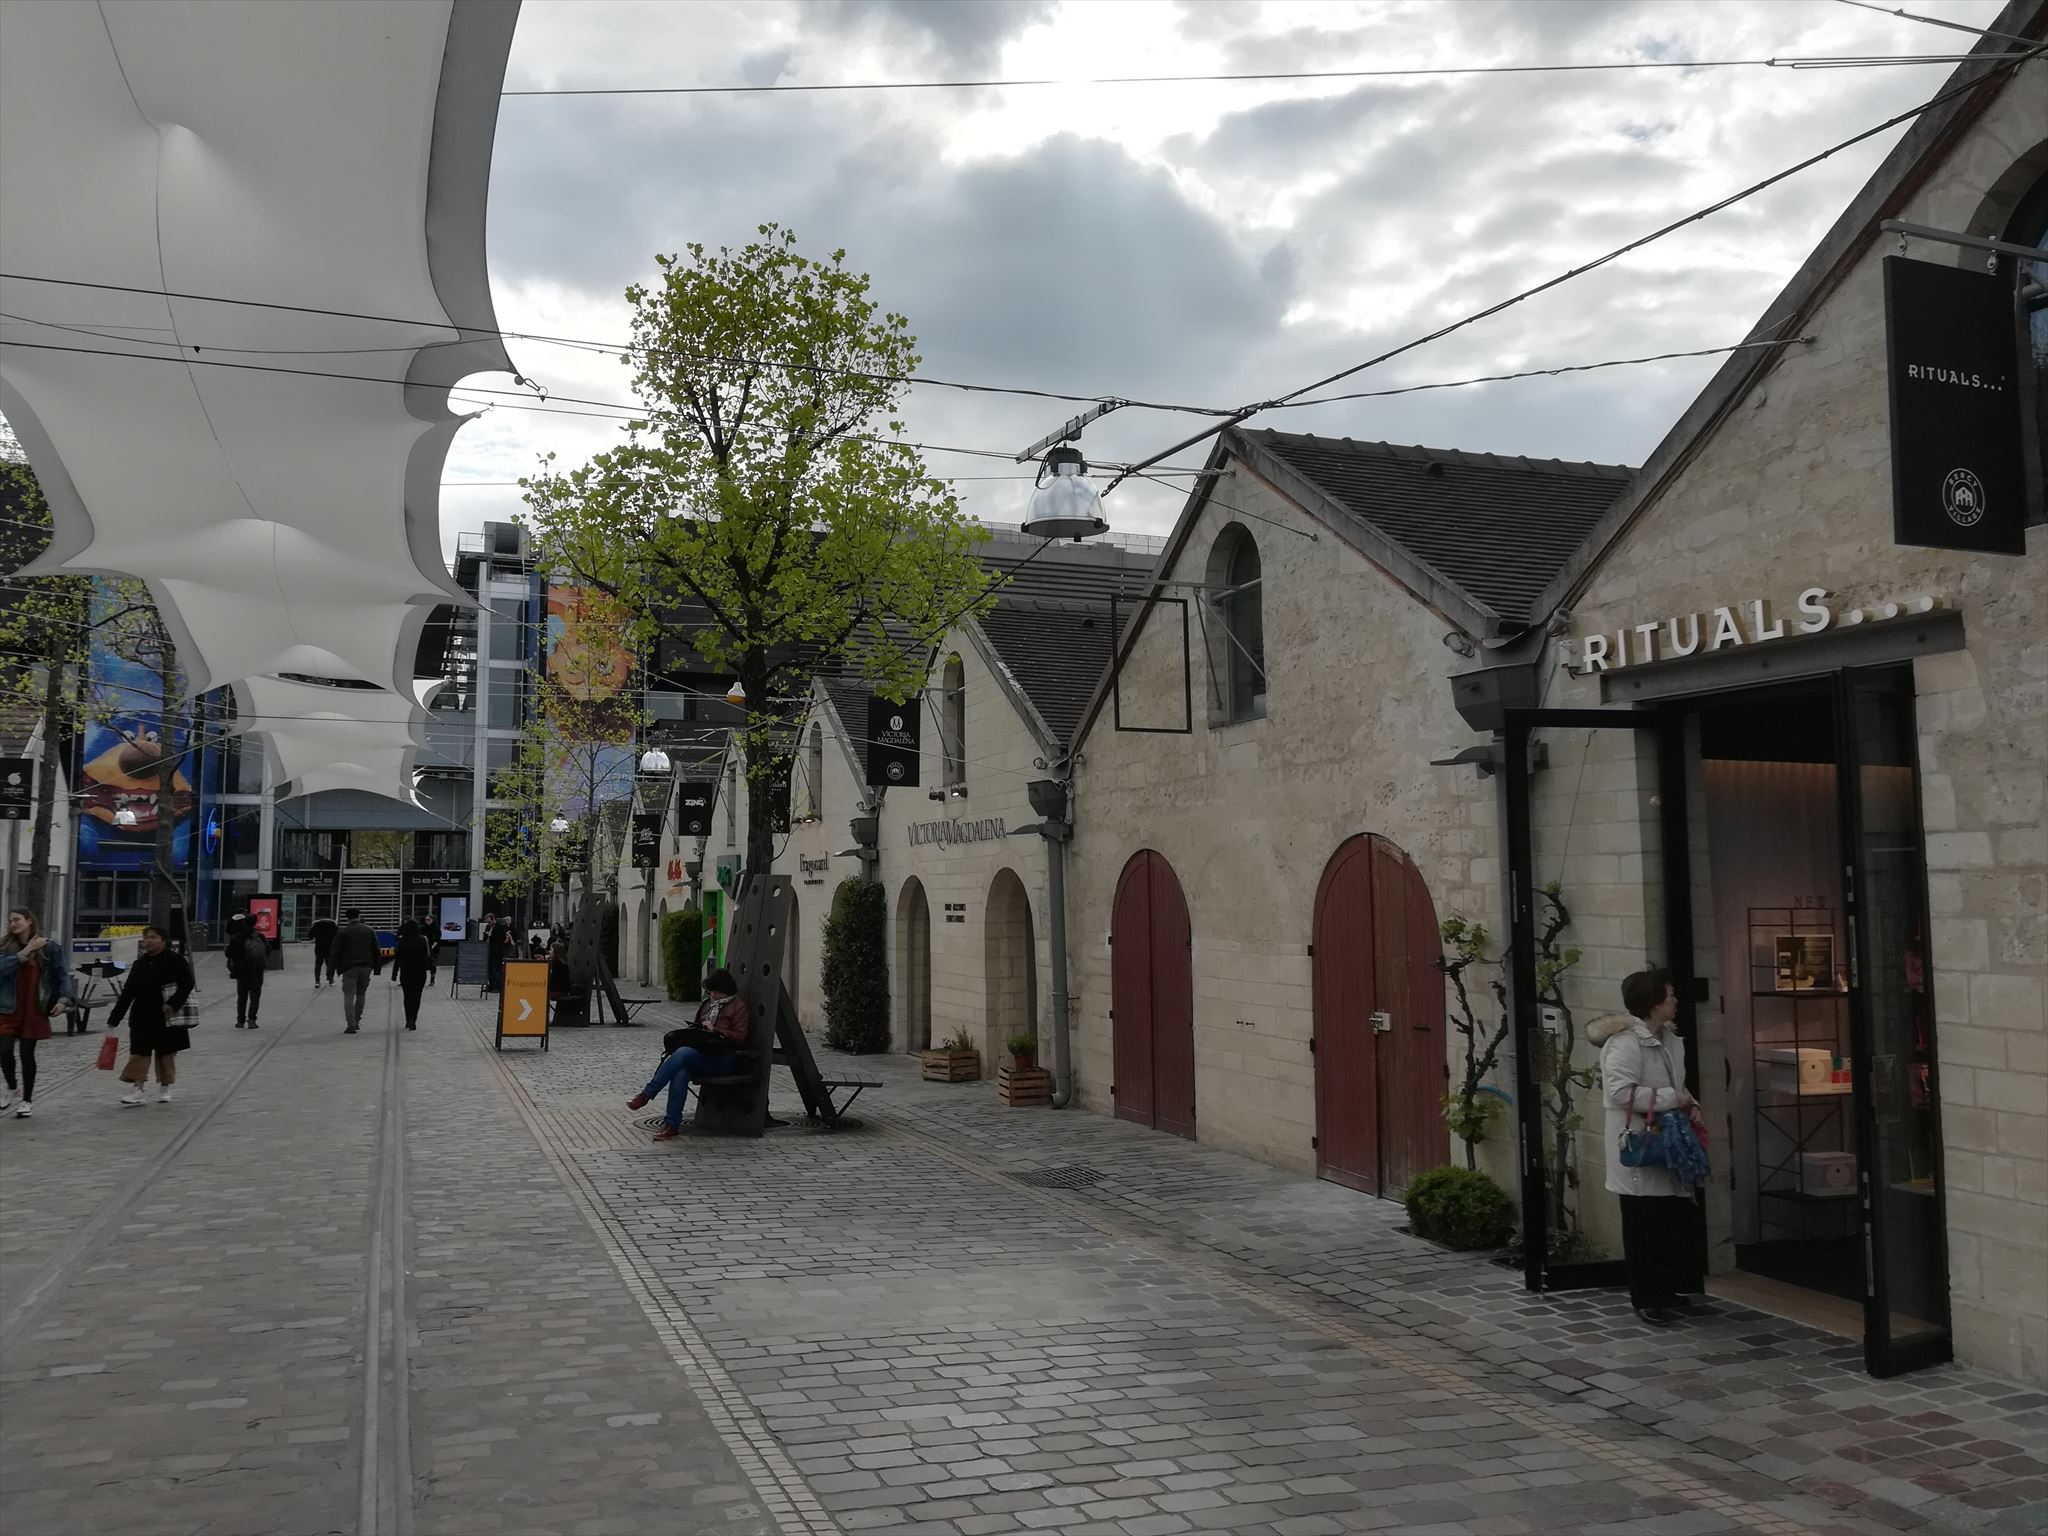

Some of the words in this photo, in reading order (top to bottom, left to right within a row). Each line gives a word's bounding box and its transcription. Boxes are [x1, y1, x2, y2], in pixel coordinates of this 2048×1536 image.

[1948, 472, 1979, 487] BERCY
[1948, 505, 1981, 524] VILLAGE
[877, 736, 915, 745] MAGDALENA
[881, 730, 911, 739] VICTORIA
